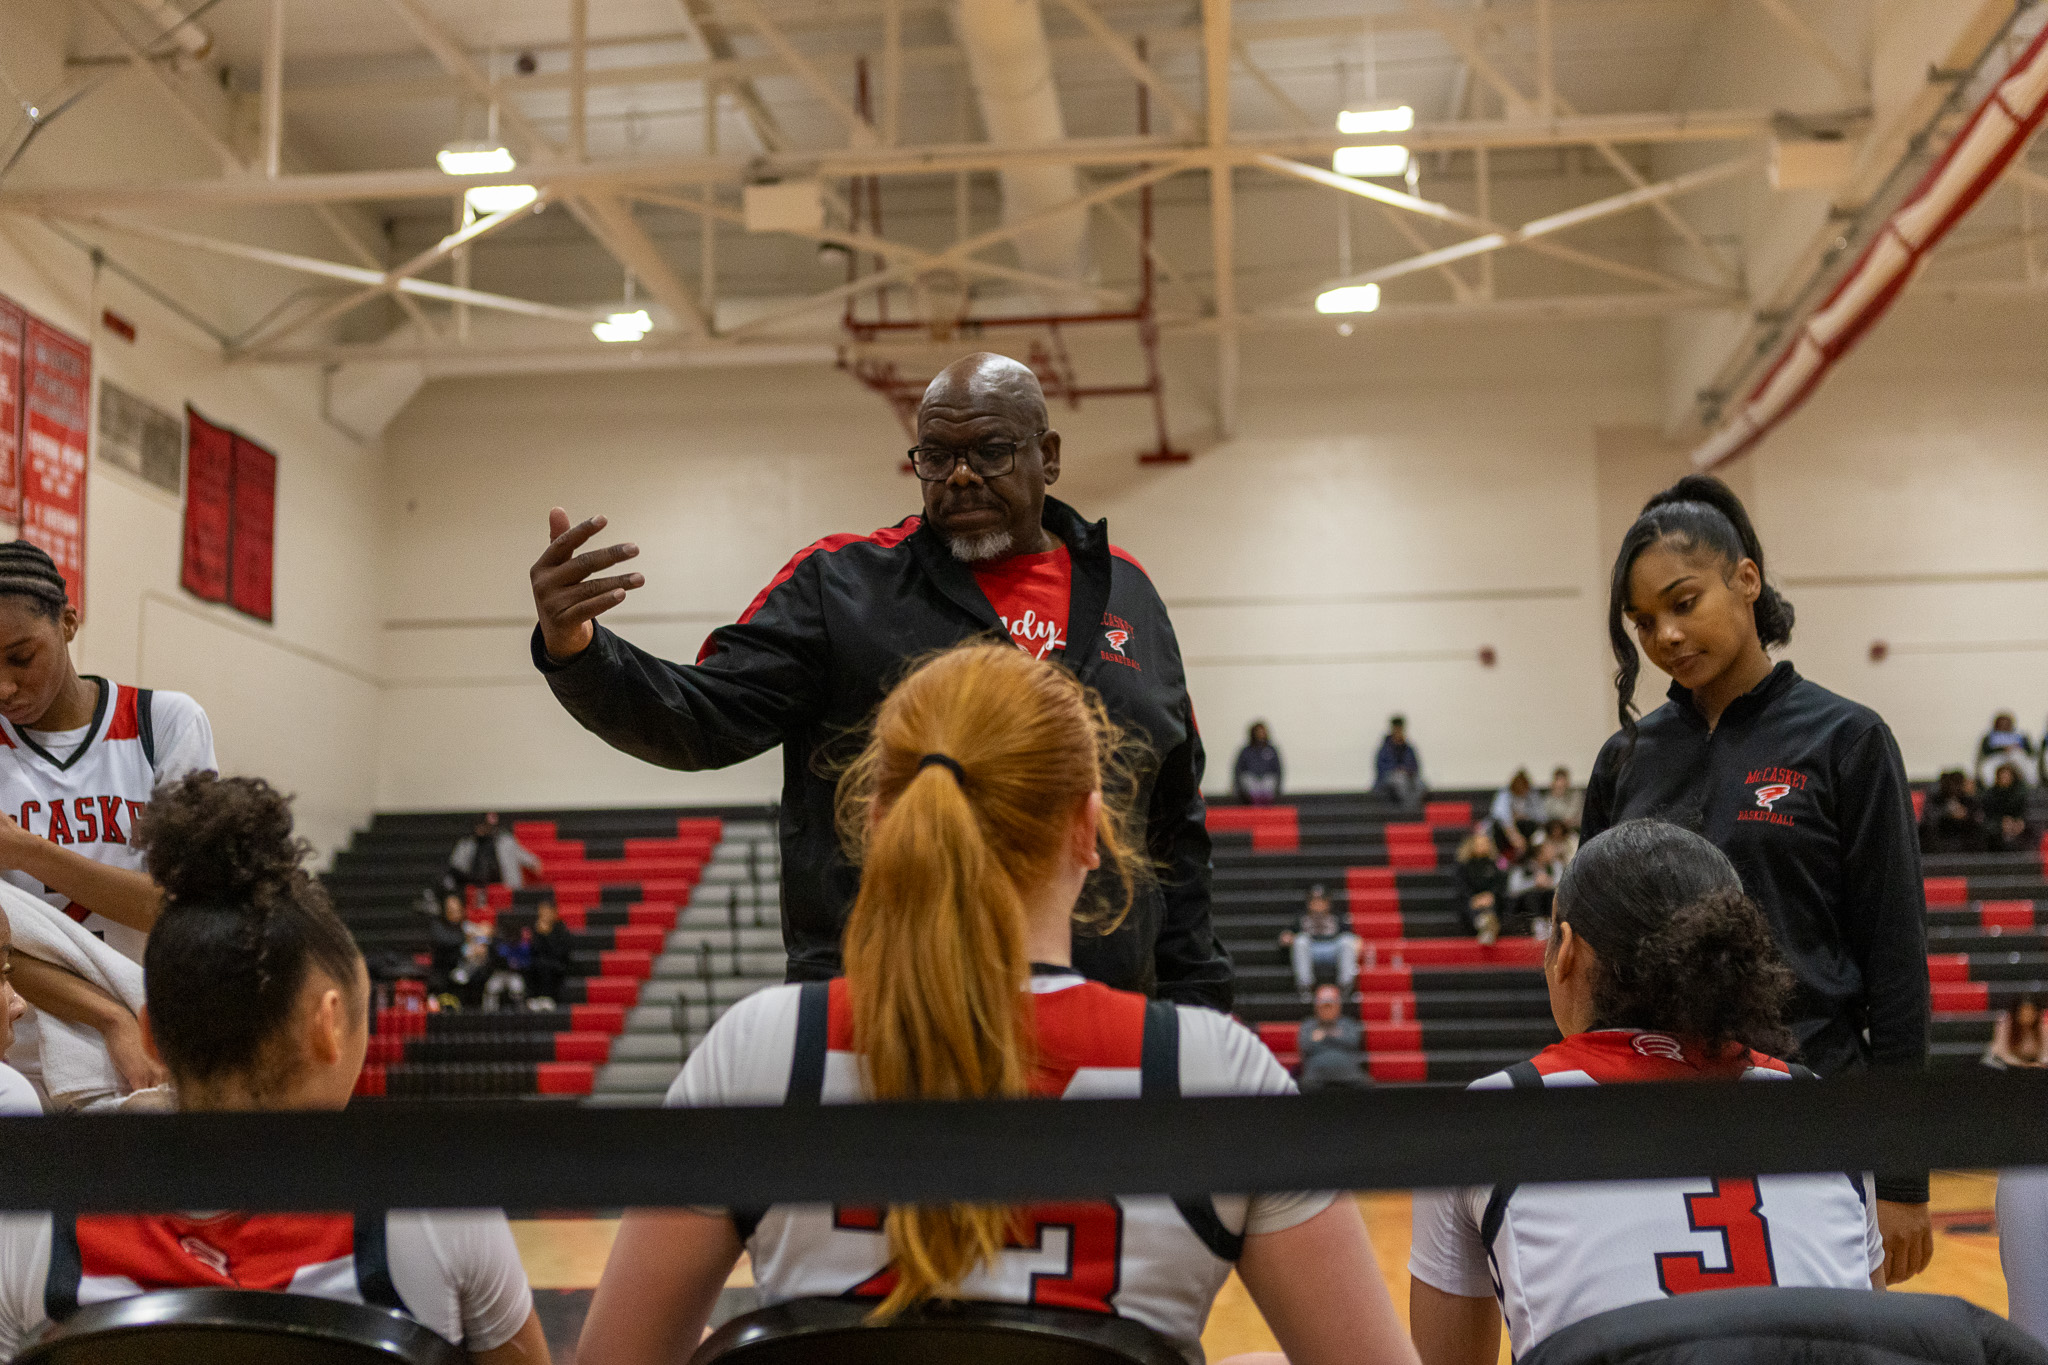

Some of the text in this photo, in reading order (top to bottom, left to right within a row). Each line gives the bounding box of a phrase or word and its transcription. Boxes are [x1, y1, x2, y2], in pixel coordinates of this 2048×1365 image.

[1100, 650, 1142, 671] BASKETBALL
[9, 796, 148, 846] CASK
[1737, 810, 1795, 827] BASKETBALL
[1654, 1176, 1780, 1298] 3
